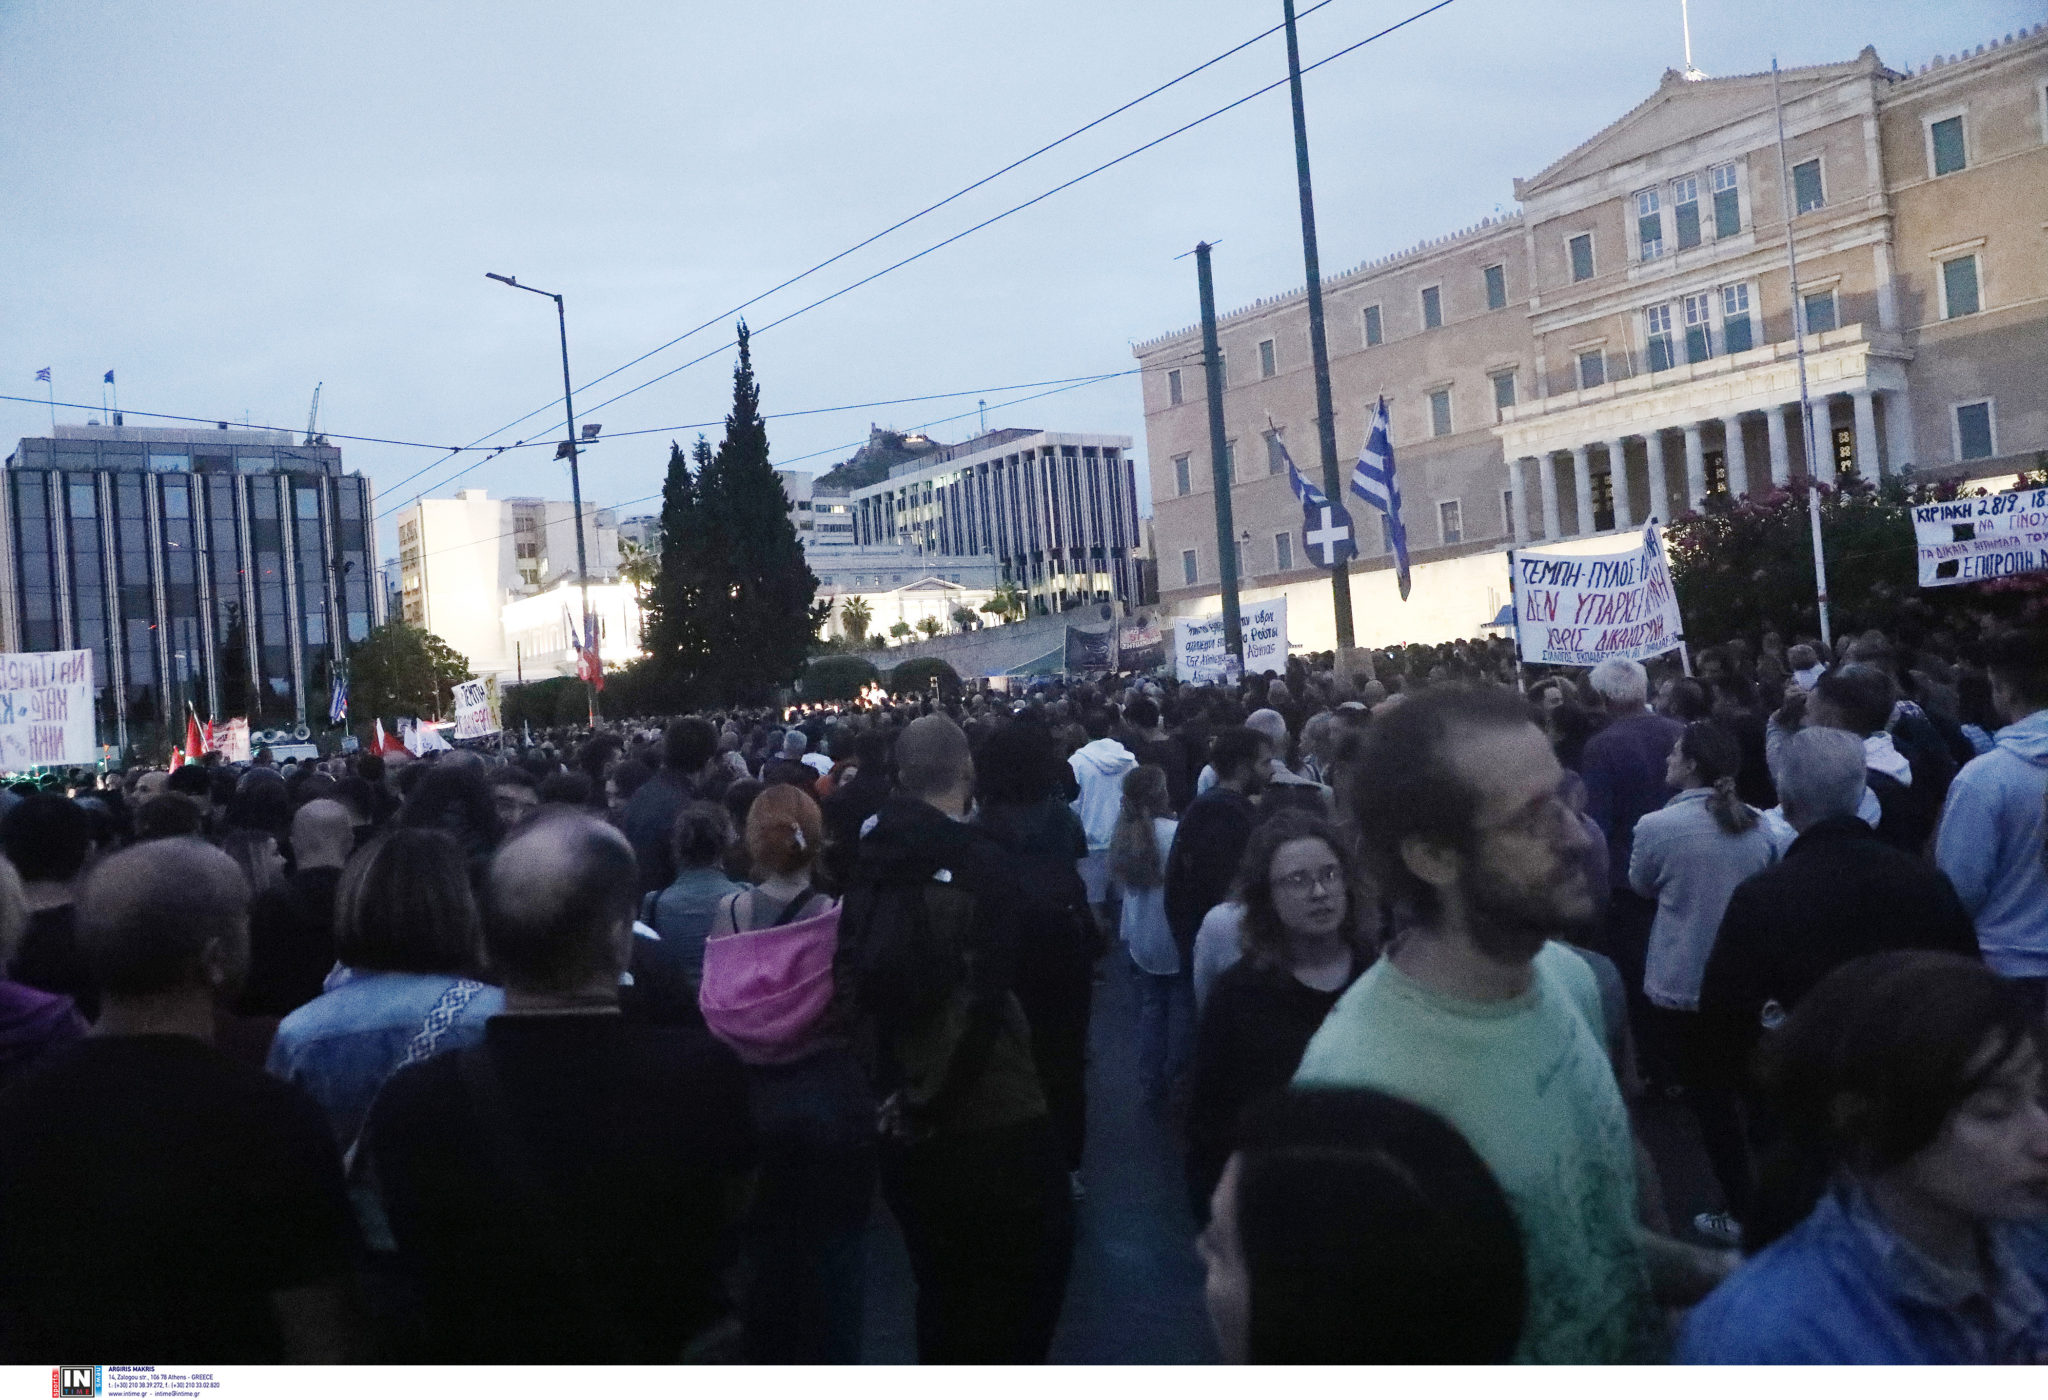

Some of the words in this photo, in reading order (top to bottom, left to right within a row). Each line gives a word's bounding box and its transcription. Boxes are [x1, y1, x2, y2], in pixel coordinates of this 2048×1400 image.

[1979, 519, 1994, 532] ΝΑ
[1963, 551, 2034, 578] ΕΠΙΤΡΟΠΗ
[1526, 590, 1560, 622] ΔΕΝ
[1574, 588, 1647, 625] ΥΠΑΡΧΕΙ
[1547, 628, 1589, 652] ΧΩΡΙΣ
[1595, 614, 1663, 652] ΔΙΚΑΙΟΣΥΝΗ
